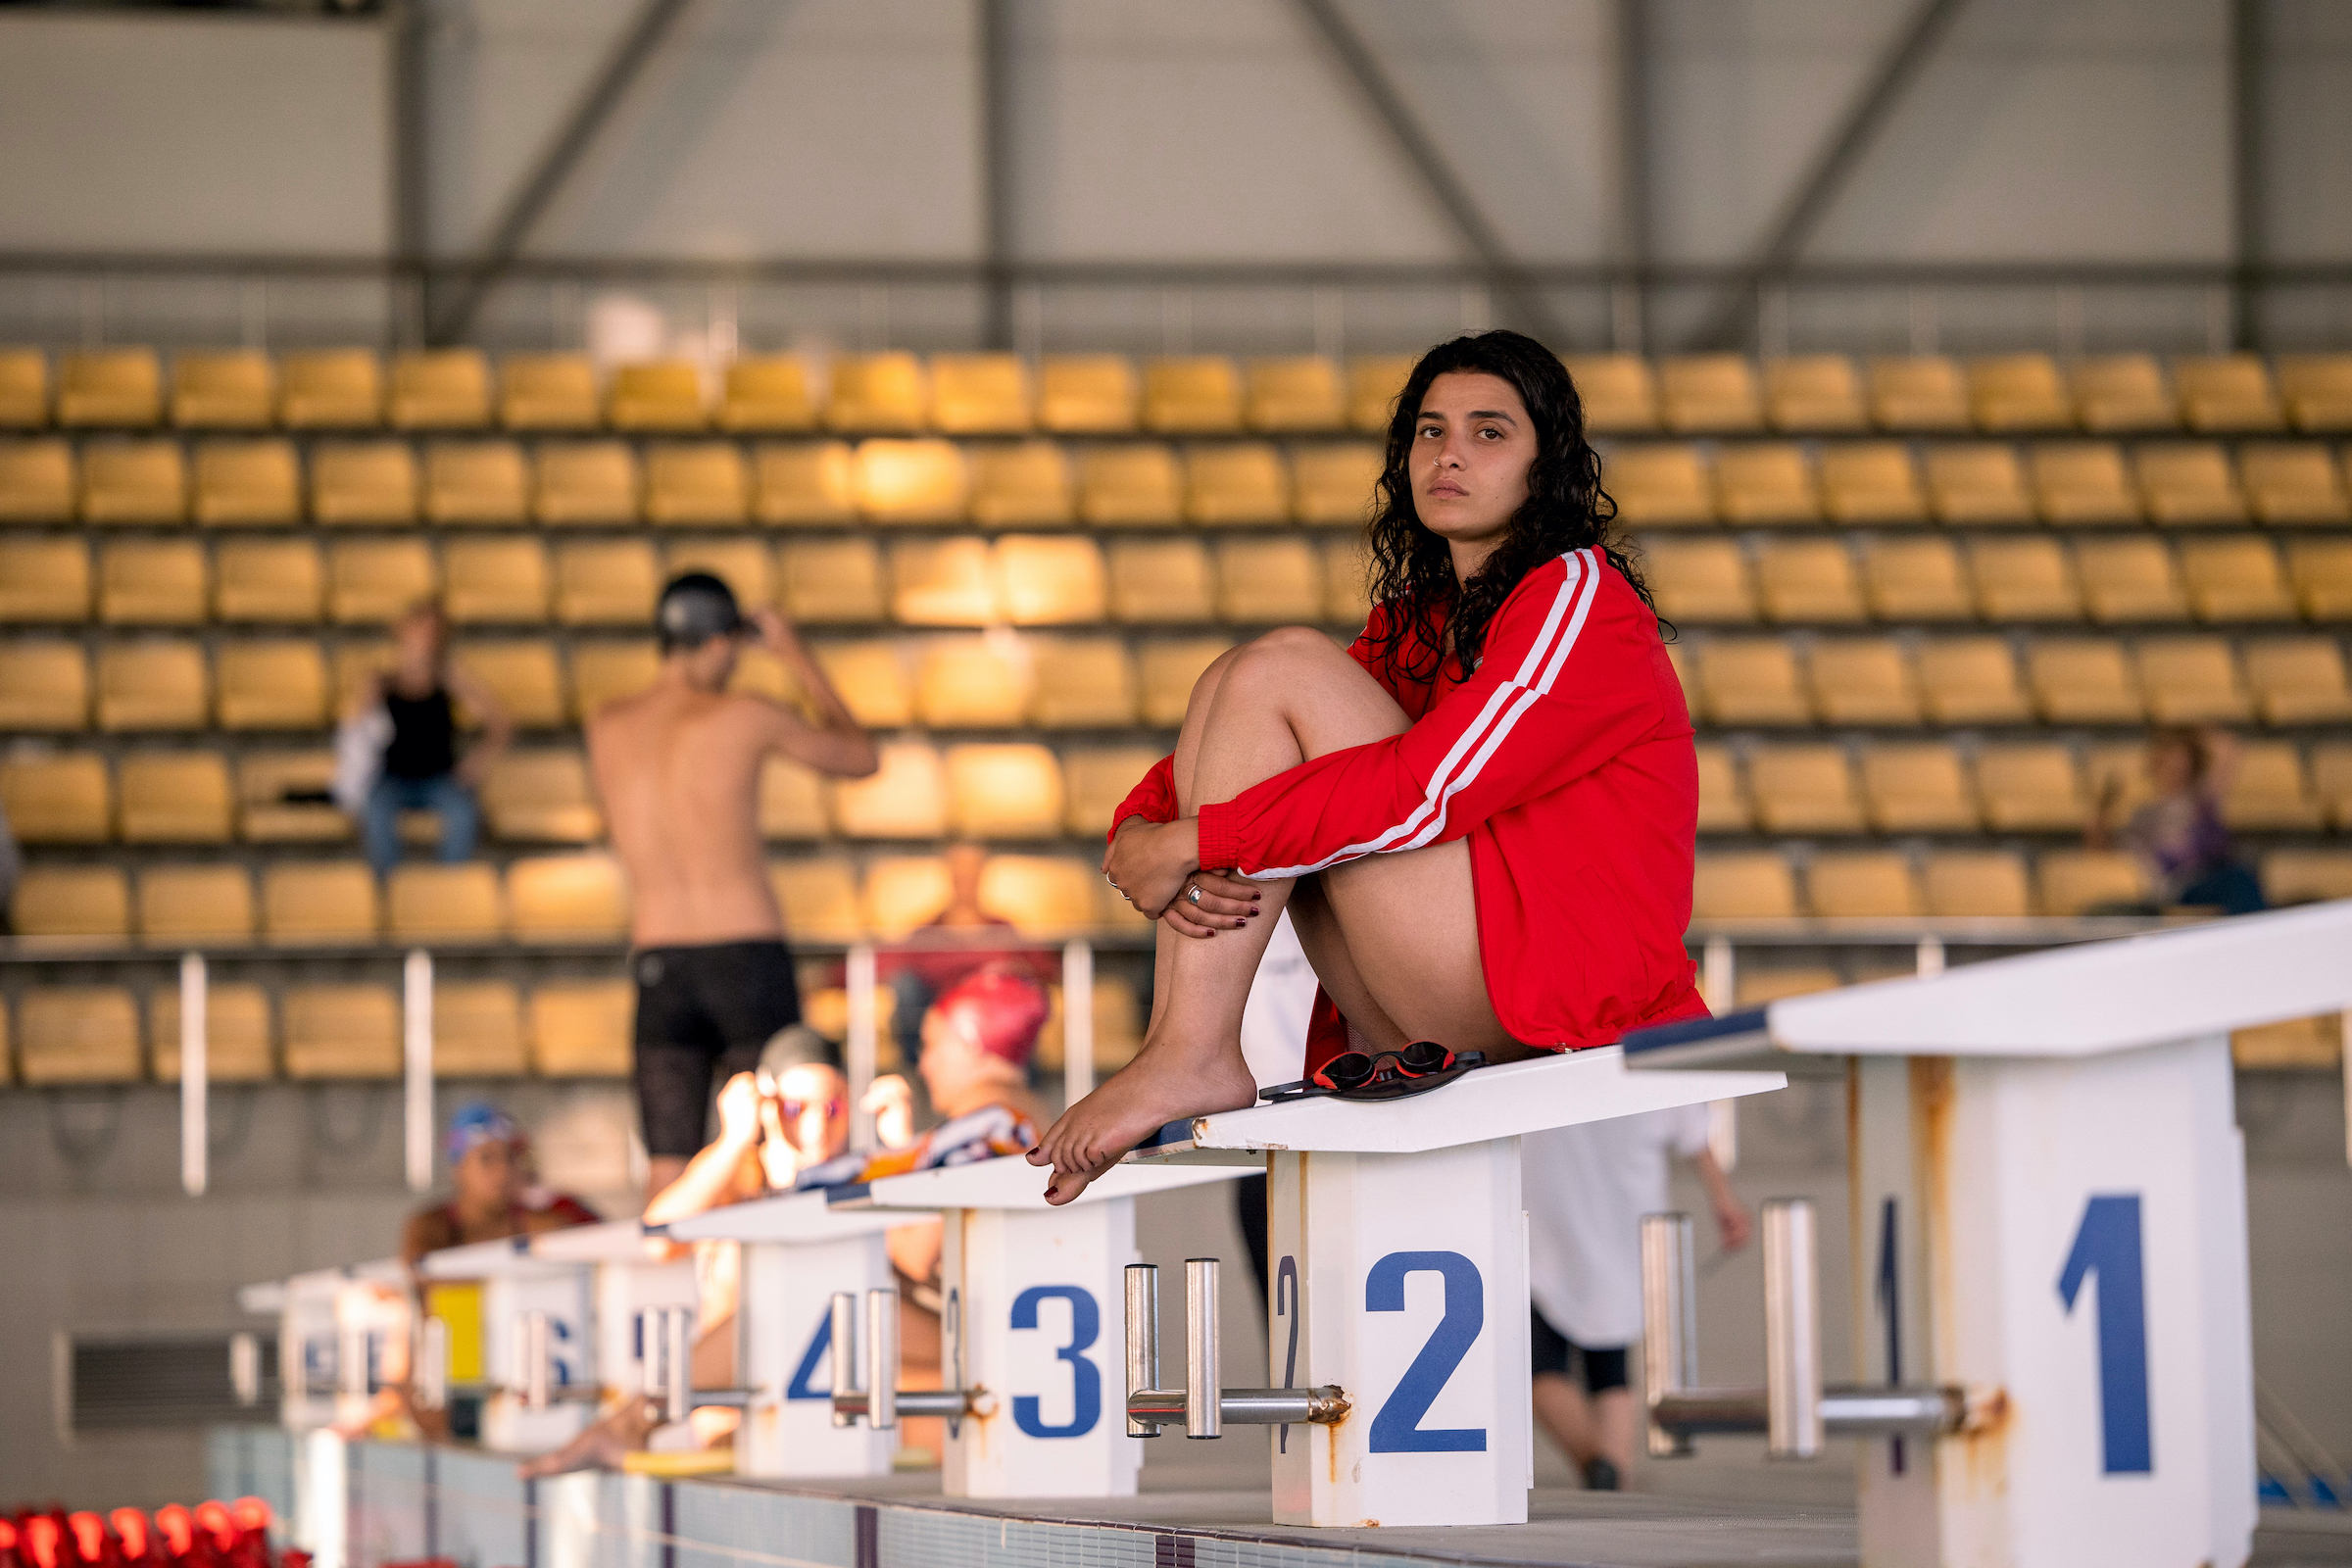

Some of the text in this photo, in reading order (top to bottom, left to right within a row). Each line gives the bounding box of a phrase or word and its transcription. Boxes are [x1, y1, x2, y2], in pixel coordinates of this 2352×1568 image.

[1010, 1285, 1102, 1439] 3
[1365, 1250, 1487, 1453] 2
[2056, 1195, 2153, 1475] 1
